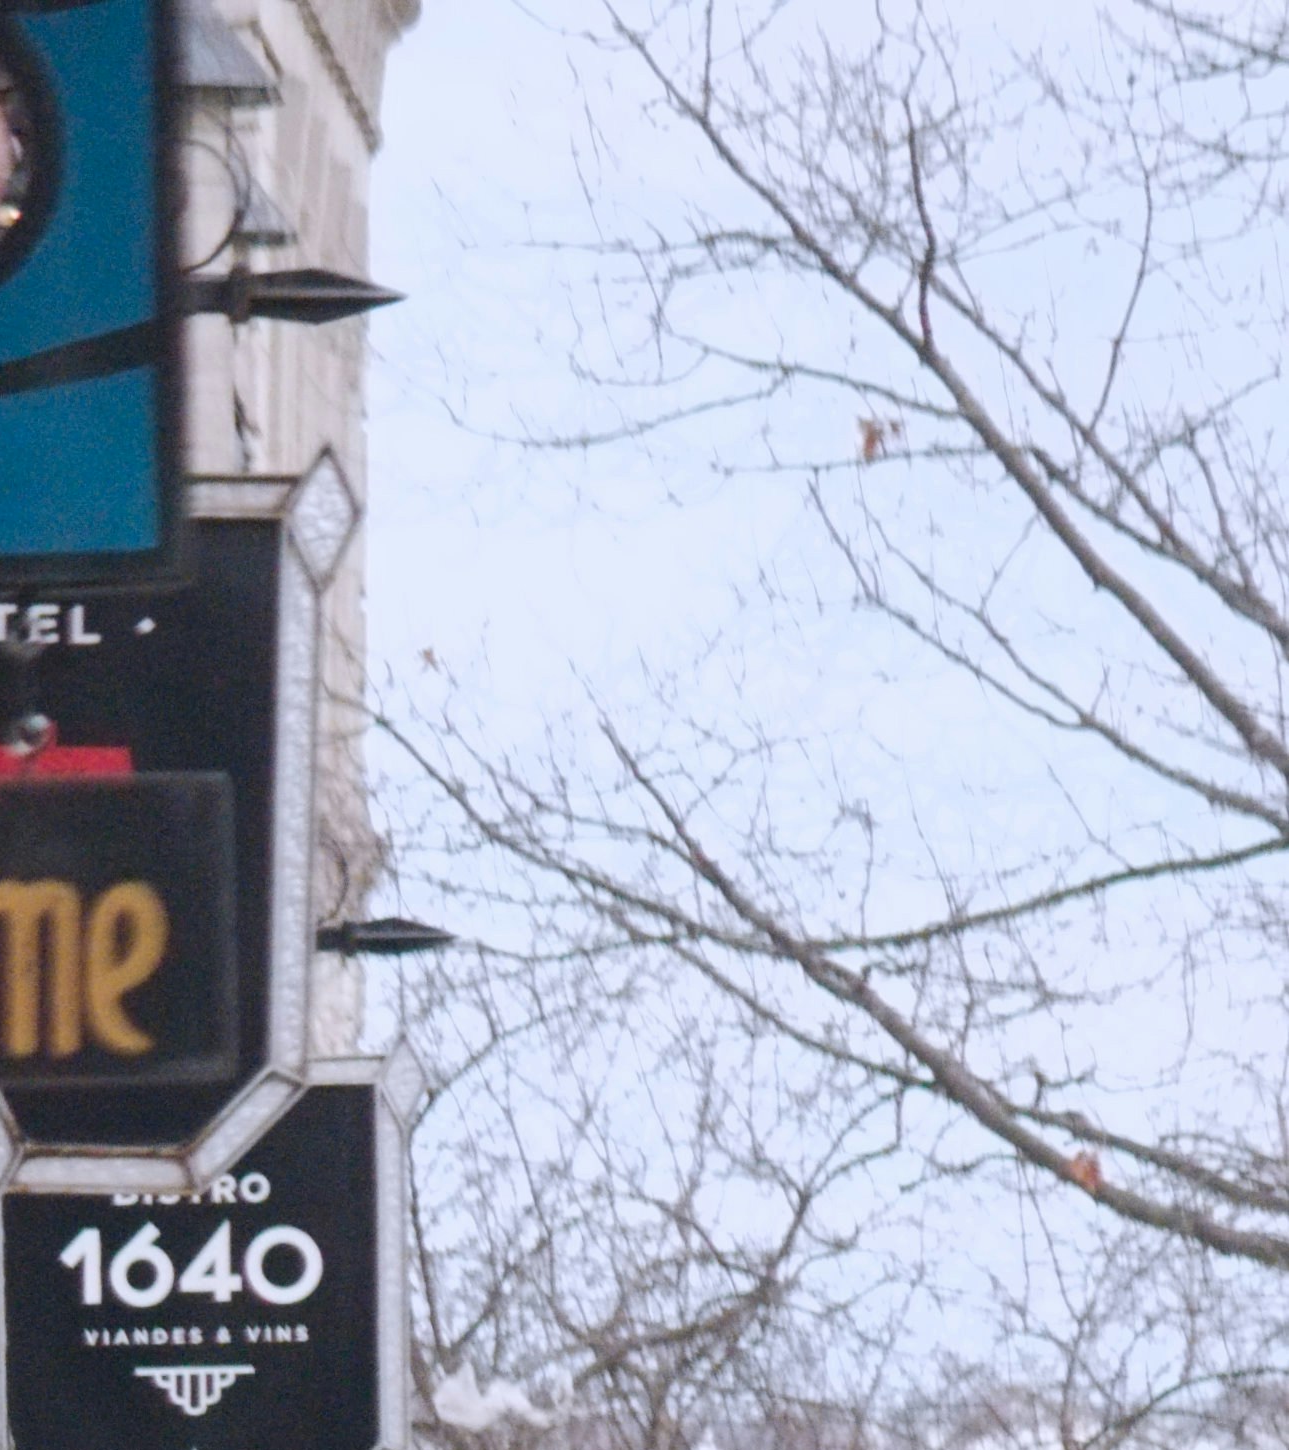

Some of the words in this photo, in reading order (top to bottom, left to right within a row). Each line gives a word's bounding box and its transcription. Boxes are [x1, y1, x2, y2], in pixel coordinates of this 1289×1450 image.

[59, 1219, 324, 1308] 1640
[83, 1325, 204, 1347] VIANDES
[216, 1324, 232, 1345] &
[245, 1323, 310, 1344] VINS
